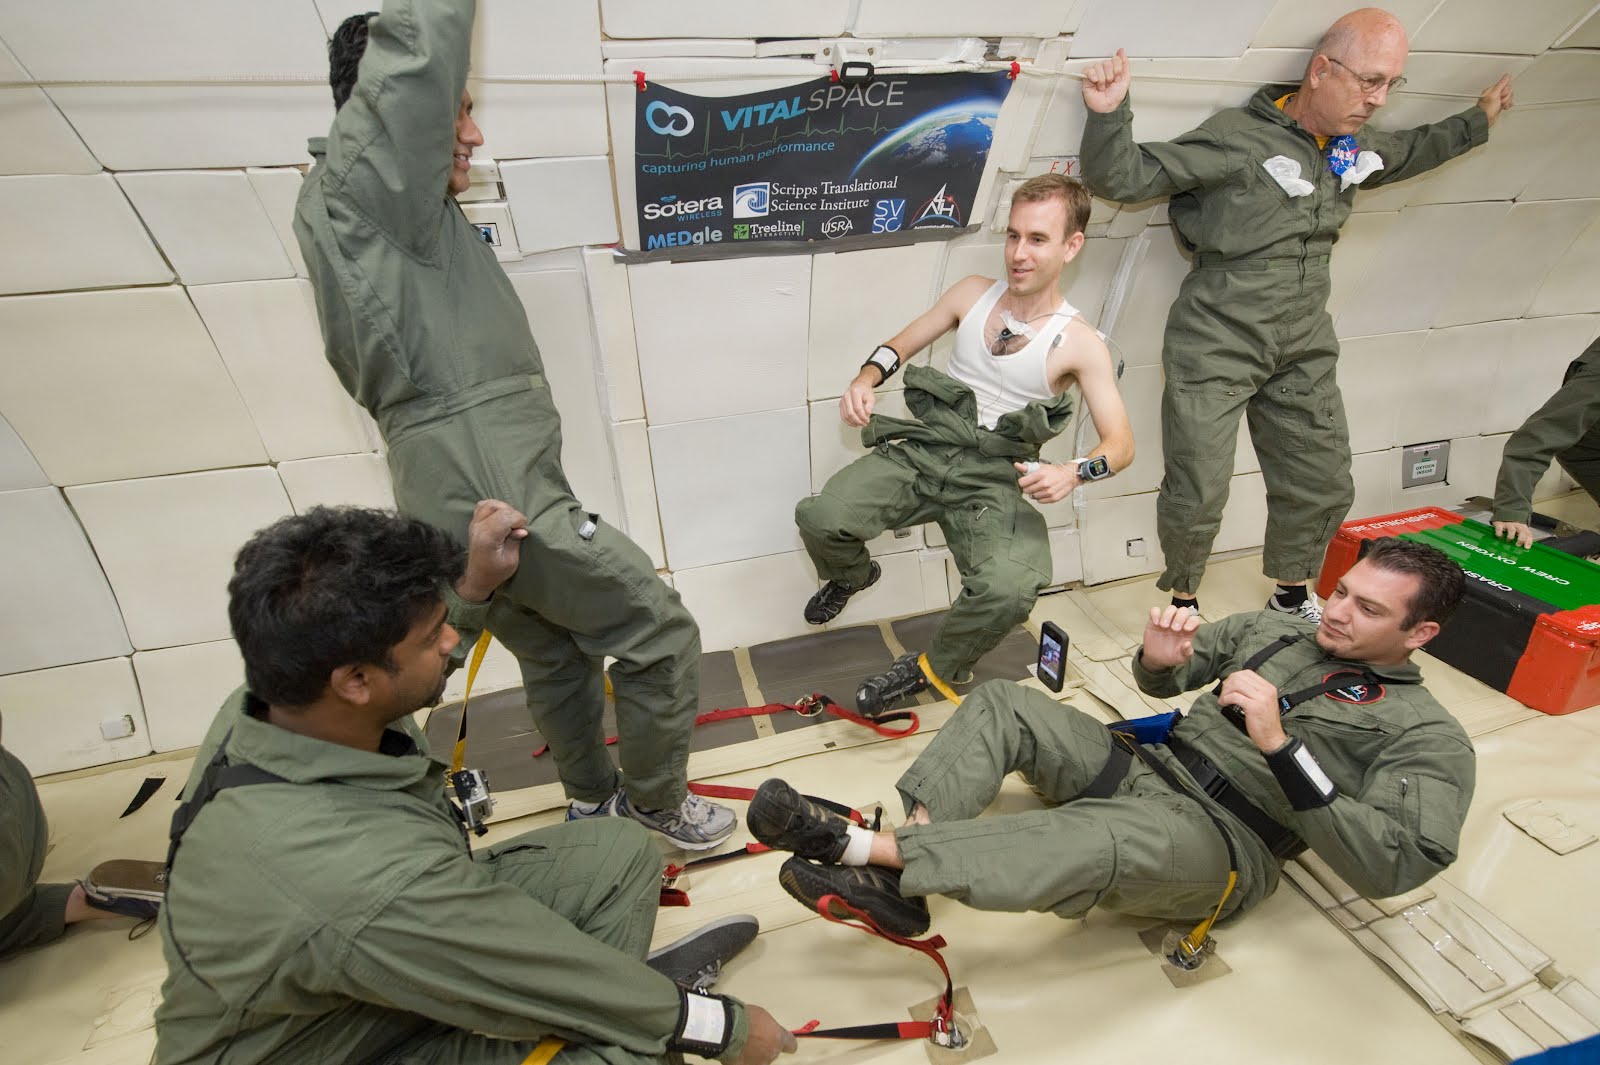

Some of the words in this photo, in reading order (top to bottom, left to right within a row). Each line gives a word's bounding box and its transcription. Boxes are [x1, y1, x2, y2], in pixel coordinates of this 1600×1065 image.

[710, 152, 754, 167] human
[757, 142, 835, 161] performance
[1049, 160, 1082, 176] EX
[771, 182, 818, 199] Scripps
[820, 176, 898, 195] Translational
[770, 199, 817, 212] Science
[819, 198, 870, 211] Institute
[677, 210, 723, 222] WIRELESS
[749, 220, 801, 235] Treeline
[821, 219, 853, 234] USRA
[647, 226, 723, 250] MEDgle
[751, 231, 800, 239] INTERACTIVE
[1456, 540, 1517, 566] OXYGEN
[1518, 566, 1571, 586] CREW
